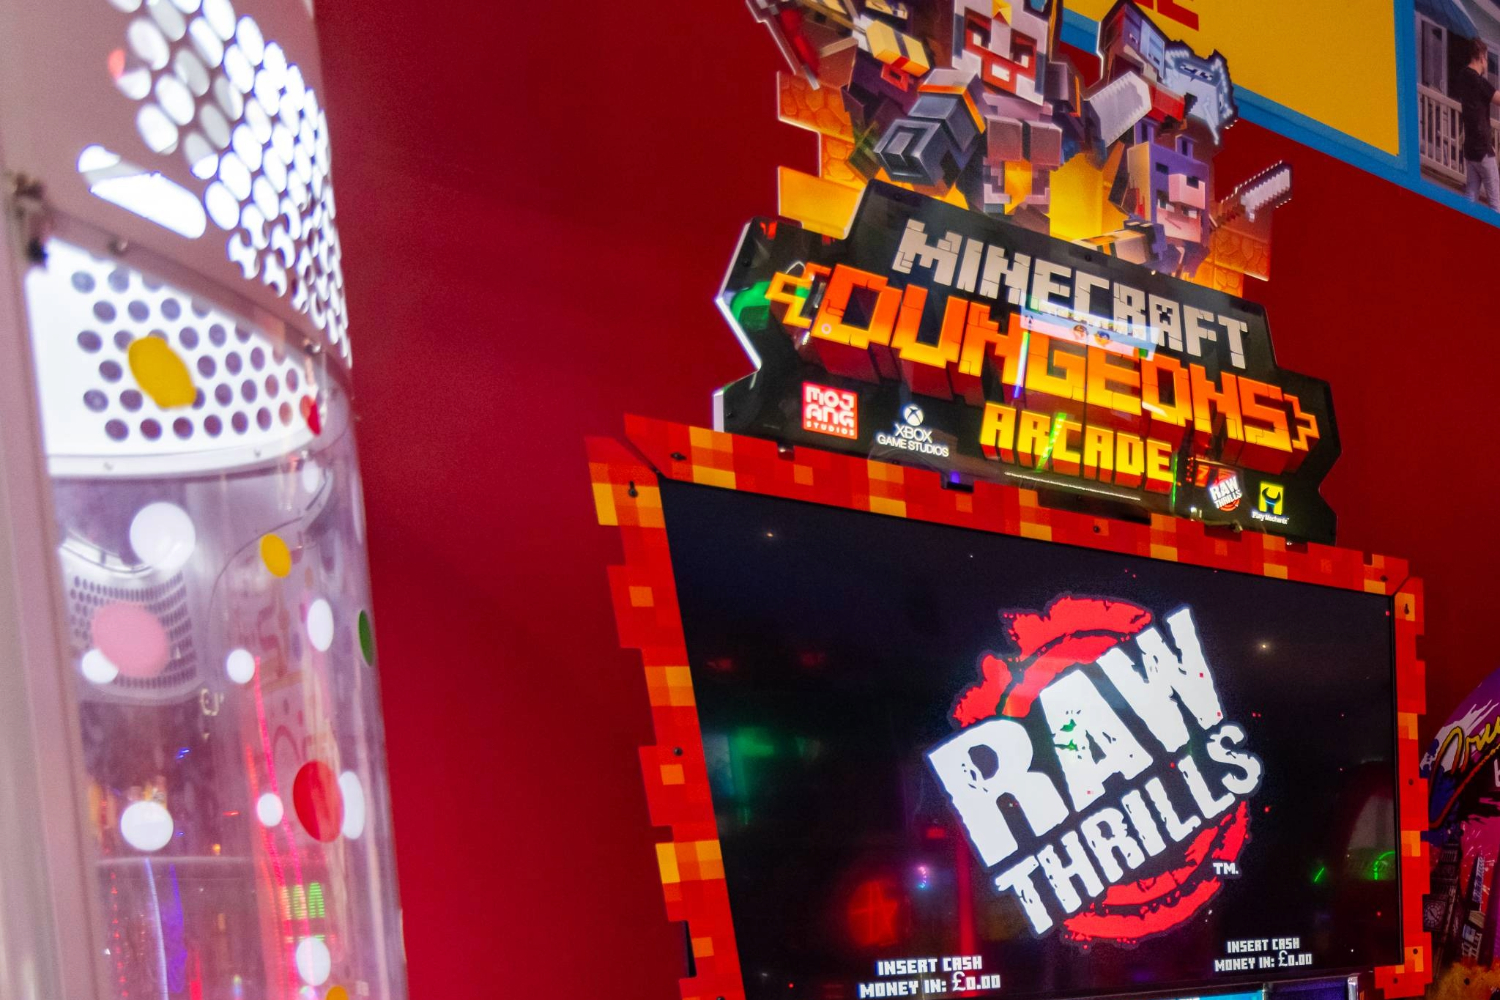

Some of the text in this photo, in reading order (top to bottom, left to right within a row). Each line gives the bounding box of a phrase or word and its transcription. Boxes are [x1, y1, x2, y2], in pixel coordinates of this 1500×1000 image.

[892, 218, 1250, 371] MINECRAFT
[811, 263, 1302, 458] DUNGEONS
[805, 421, 854, 436] STUDIOS
[894, 423, 932, 443] XBOX
[877, 434, 949, 457] GAME STUDIOS
[980, 401, 1177, 488] ARCADE
[1209, 476, 1239, 500] RAW
[1215, 489, 1243, 509] THRILLS
[928, 605, 1224, 868] RAW
[994, 724, 1264, 935] THRILLS
[1227, 937, 1300, 954] INSERT CASH
[876, 955, 983, 976] INSERT CASH
[1214, 950, 1313, 972] MONEY IN: £0.00
[859, 971, 1001, 999] MONEY IN: £0.00
